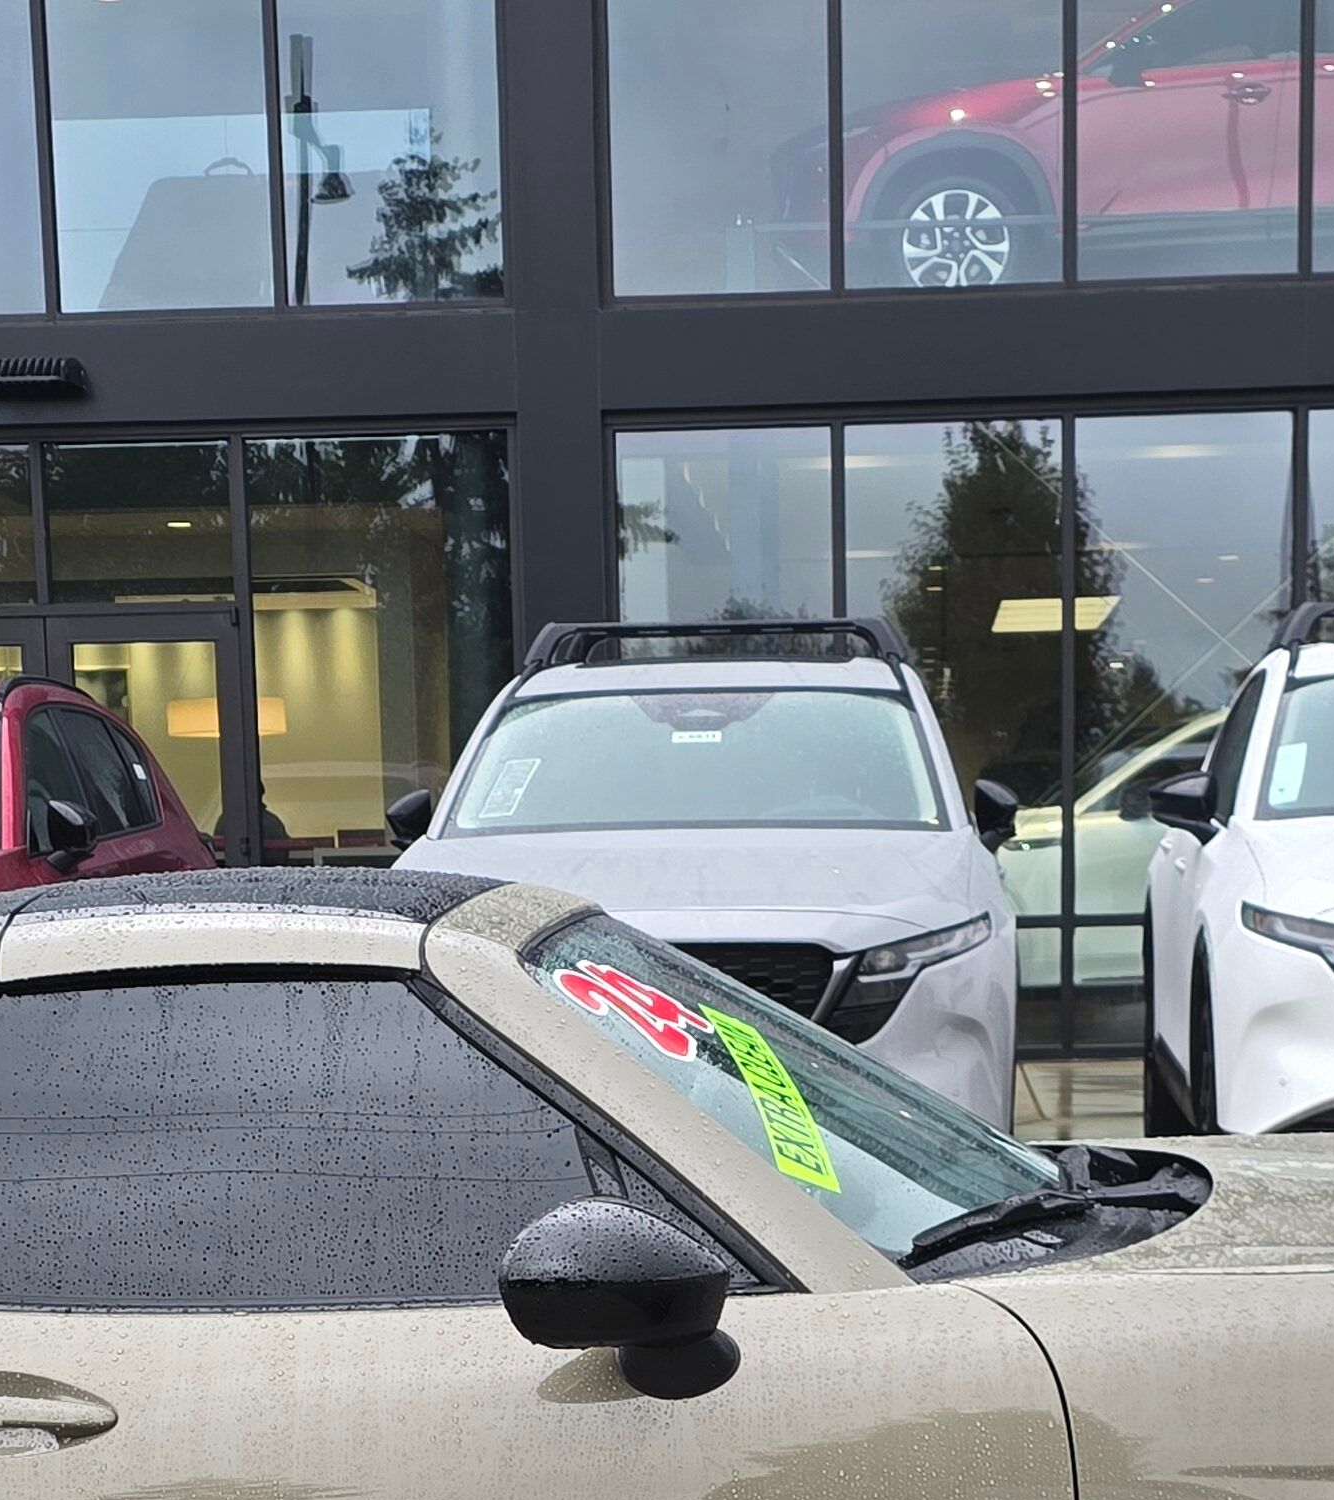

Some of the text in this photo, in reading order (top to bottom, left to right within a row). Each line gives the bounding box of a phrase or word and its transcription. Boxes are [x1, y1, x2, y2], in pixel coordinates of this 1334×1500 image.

[554, 960, 713, 1061] 24
[710, 1013, 827, 1176] EXTRA CLEAN
